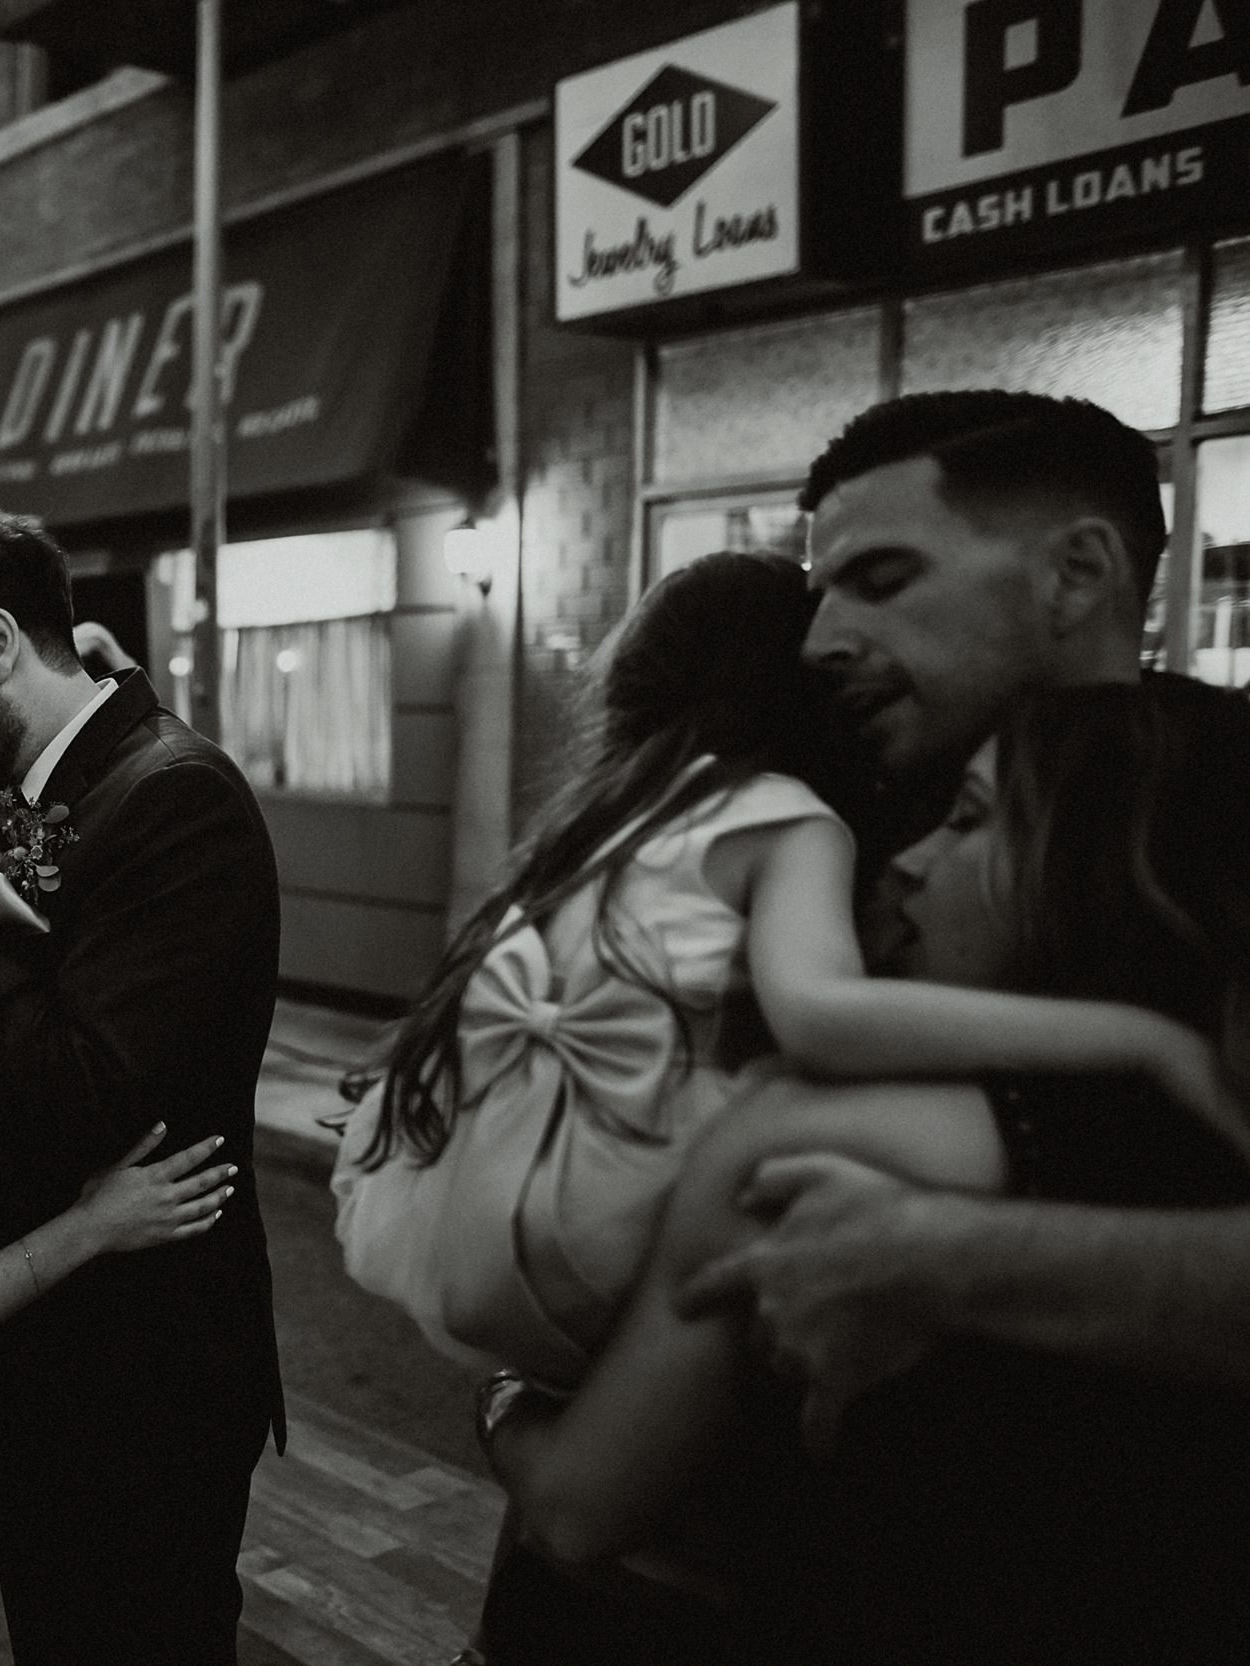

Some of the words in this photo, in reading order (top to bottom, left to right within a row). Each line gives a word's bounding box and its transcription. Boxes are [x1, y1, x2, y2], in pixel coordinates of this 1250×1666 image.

[621, 90, 716, 178] GOLD
[692, 199, 779, 258] Loans
[922, 185, 1033, 244] CASH
[1046, 146, 1204, 216] LOANS
